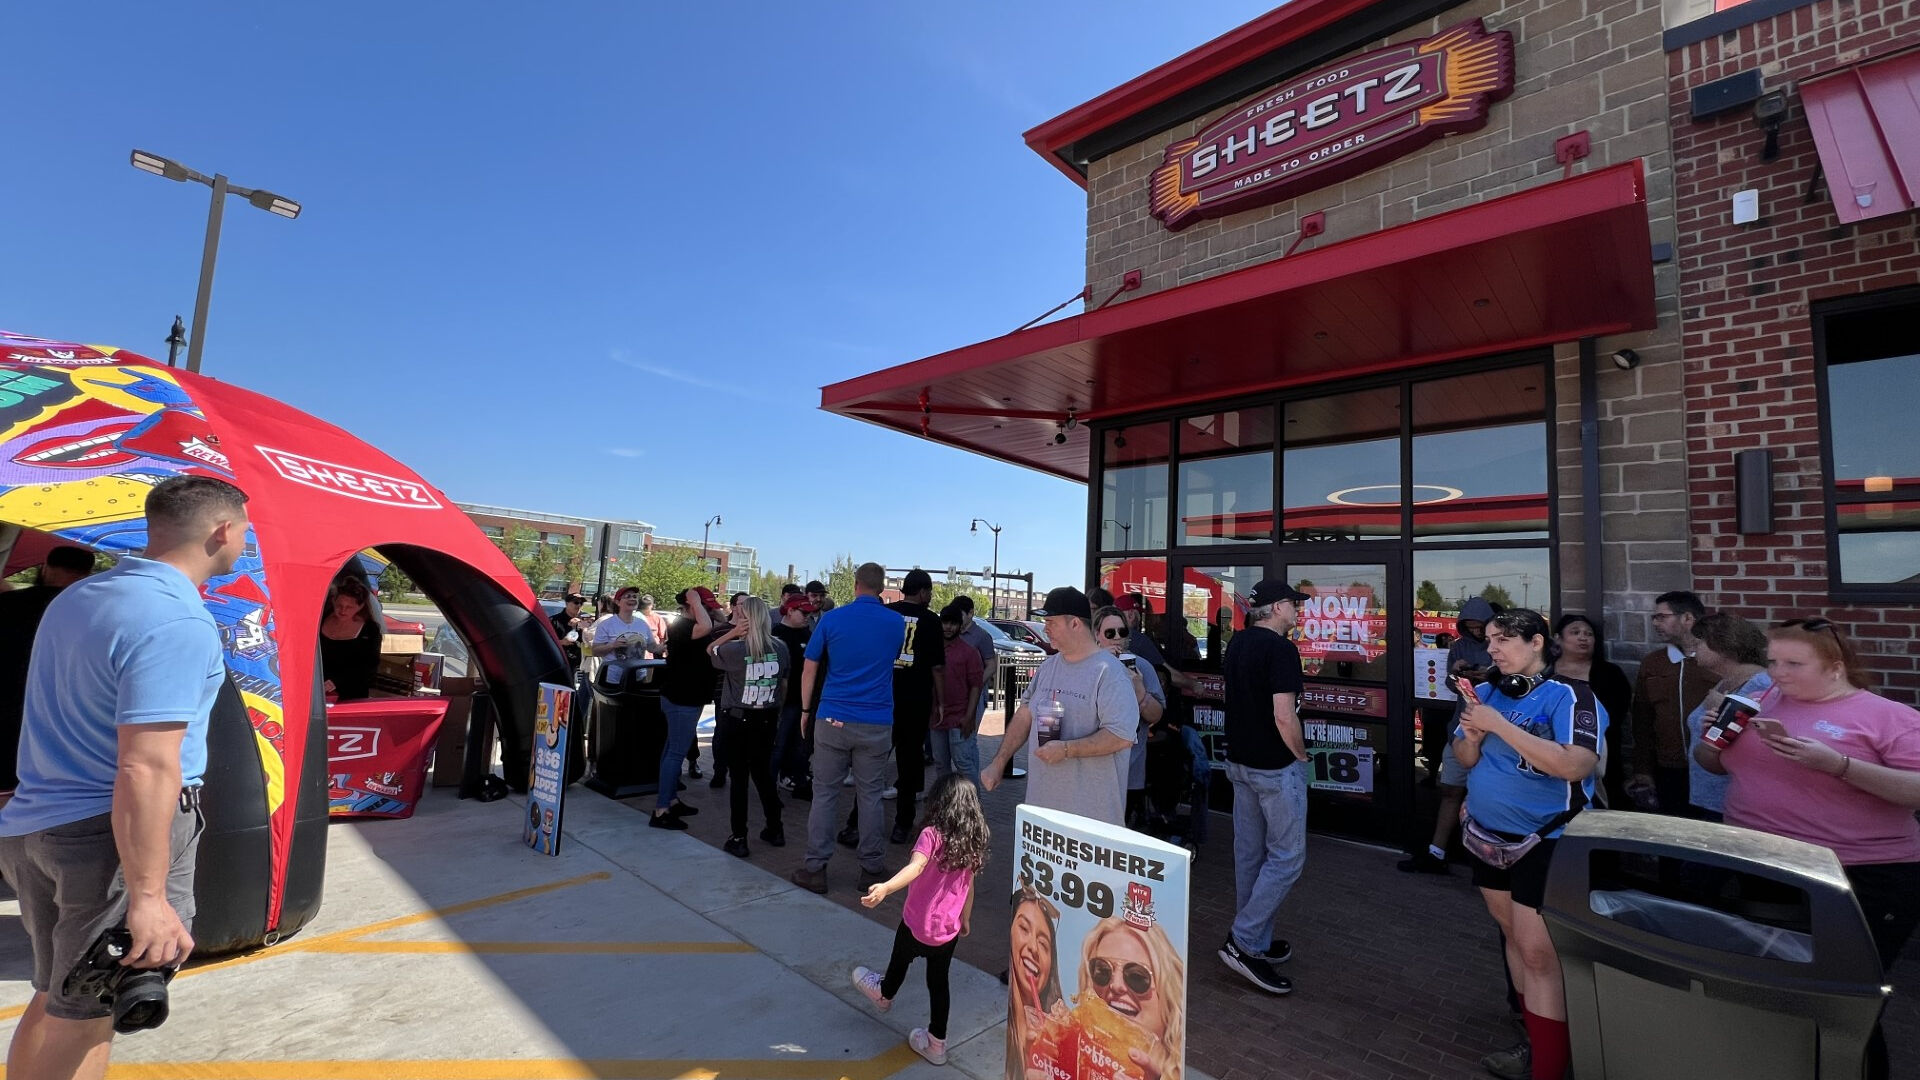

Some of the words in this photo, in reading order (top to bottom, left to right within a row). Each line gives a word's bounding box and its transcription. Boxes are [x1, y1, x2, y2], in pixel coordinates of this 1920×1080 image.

[1247, 90, 1295, 118] FRESH
[1306, 69, 1349, 91] FOOD
[1191, 62, 1422, 179] SHEETZ
[1234, 168, 1272, 189] MADE
[1280, 158, 1300, 172] TO
[1309, 134, 1366, 161] ORDER
[276, 455, 429, 503] SHEETZ
[1304, 596, 1368, 619] NOW
[1304, 618, 1369, 642] OPEN
[745, 661, 780, 681] APP
[1304, 692, 1367, 705] SHEETZ
[1304, 723, 1327, 742] WE'RE
[1327, 724, 1354, 743] HIRING
[1021, 840, 1063, 865] STARTING
[1065, 859, 1079, 871] AT
[1022, 820, 1165, 882] REFRESHERZ
[1020, 853, 1115, 919] $3.99
[1132, 887, 1148, 897] WITH
[1032, 1053, 1072, 1080] Coffeez
[1080, 1039, 1126, 1075] Coffeez
